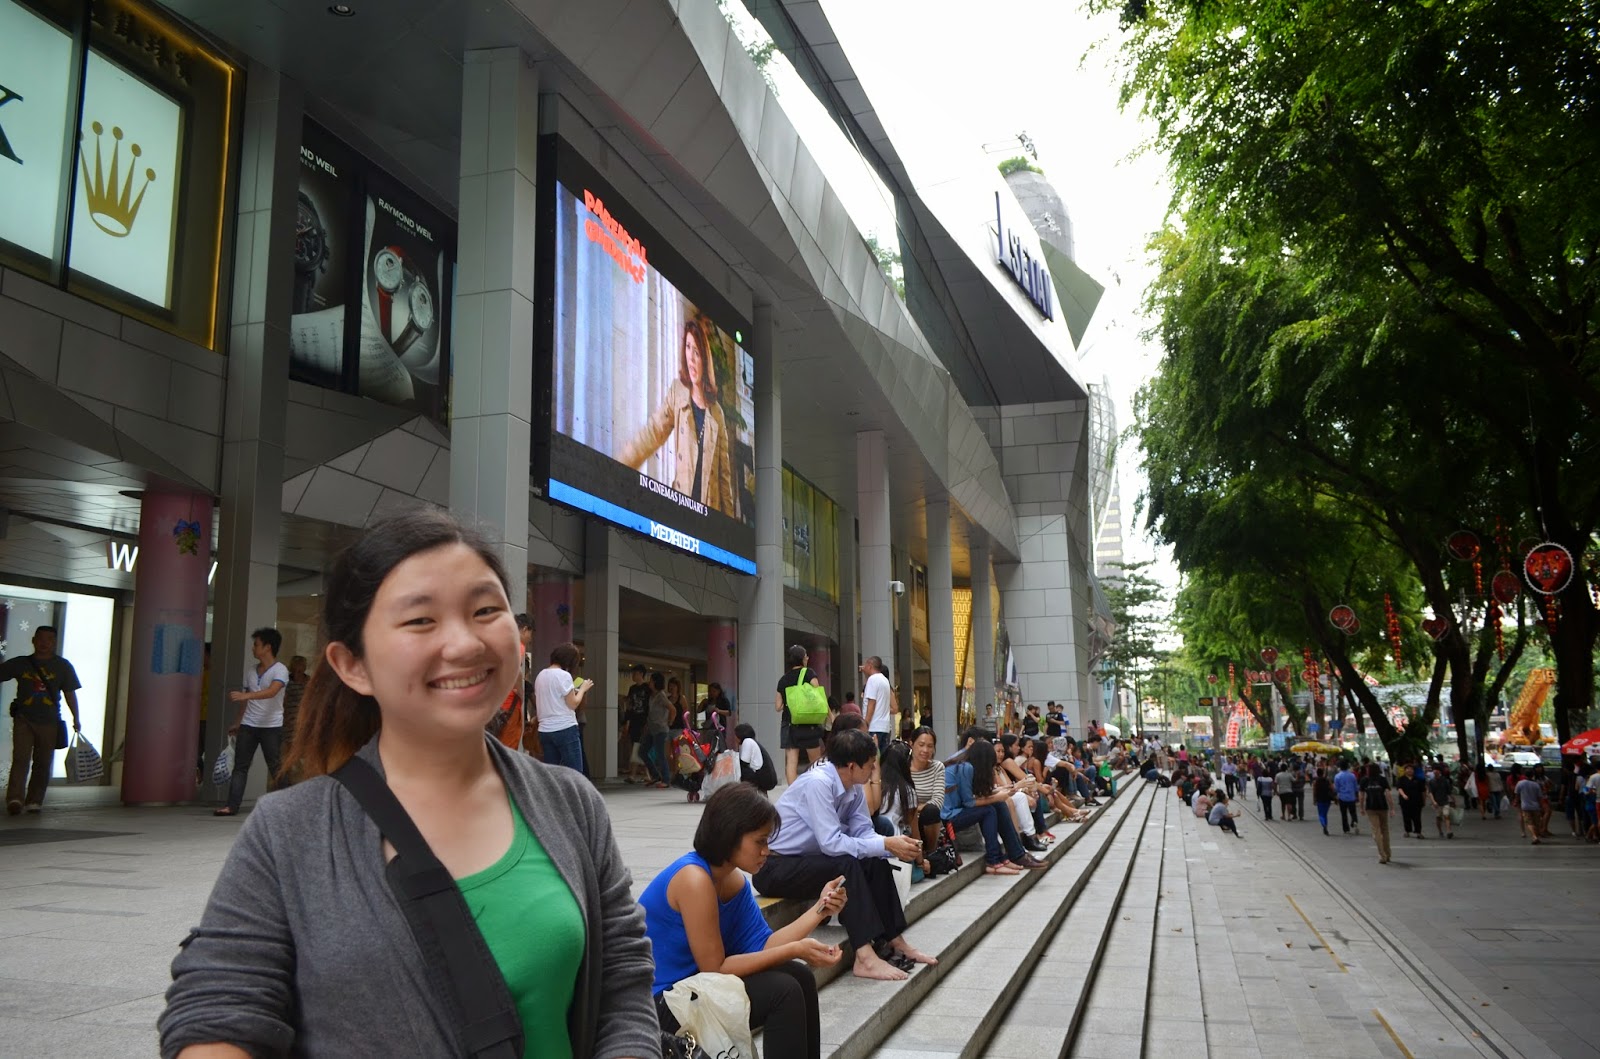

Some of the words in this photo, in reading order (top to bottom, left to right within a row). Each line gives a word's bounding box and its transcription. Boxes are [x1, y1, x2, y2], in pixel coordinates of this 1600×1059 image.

[315, 155, 338, 178] WEIL
[378, 197, 415, 228] RAYMOND
[415, 223, 434, 242] WEIL
[584, 188, 648, 266] PARENTAL
[584, 218, 646, 285] GUIDANCE
[639, 474, 649, 489] IN
[648, 479, 679, 503] CINEMAS
[678, 493, 705, 516] JANUARY
[704, 505, 709, 517] 3
